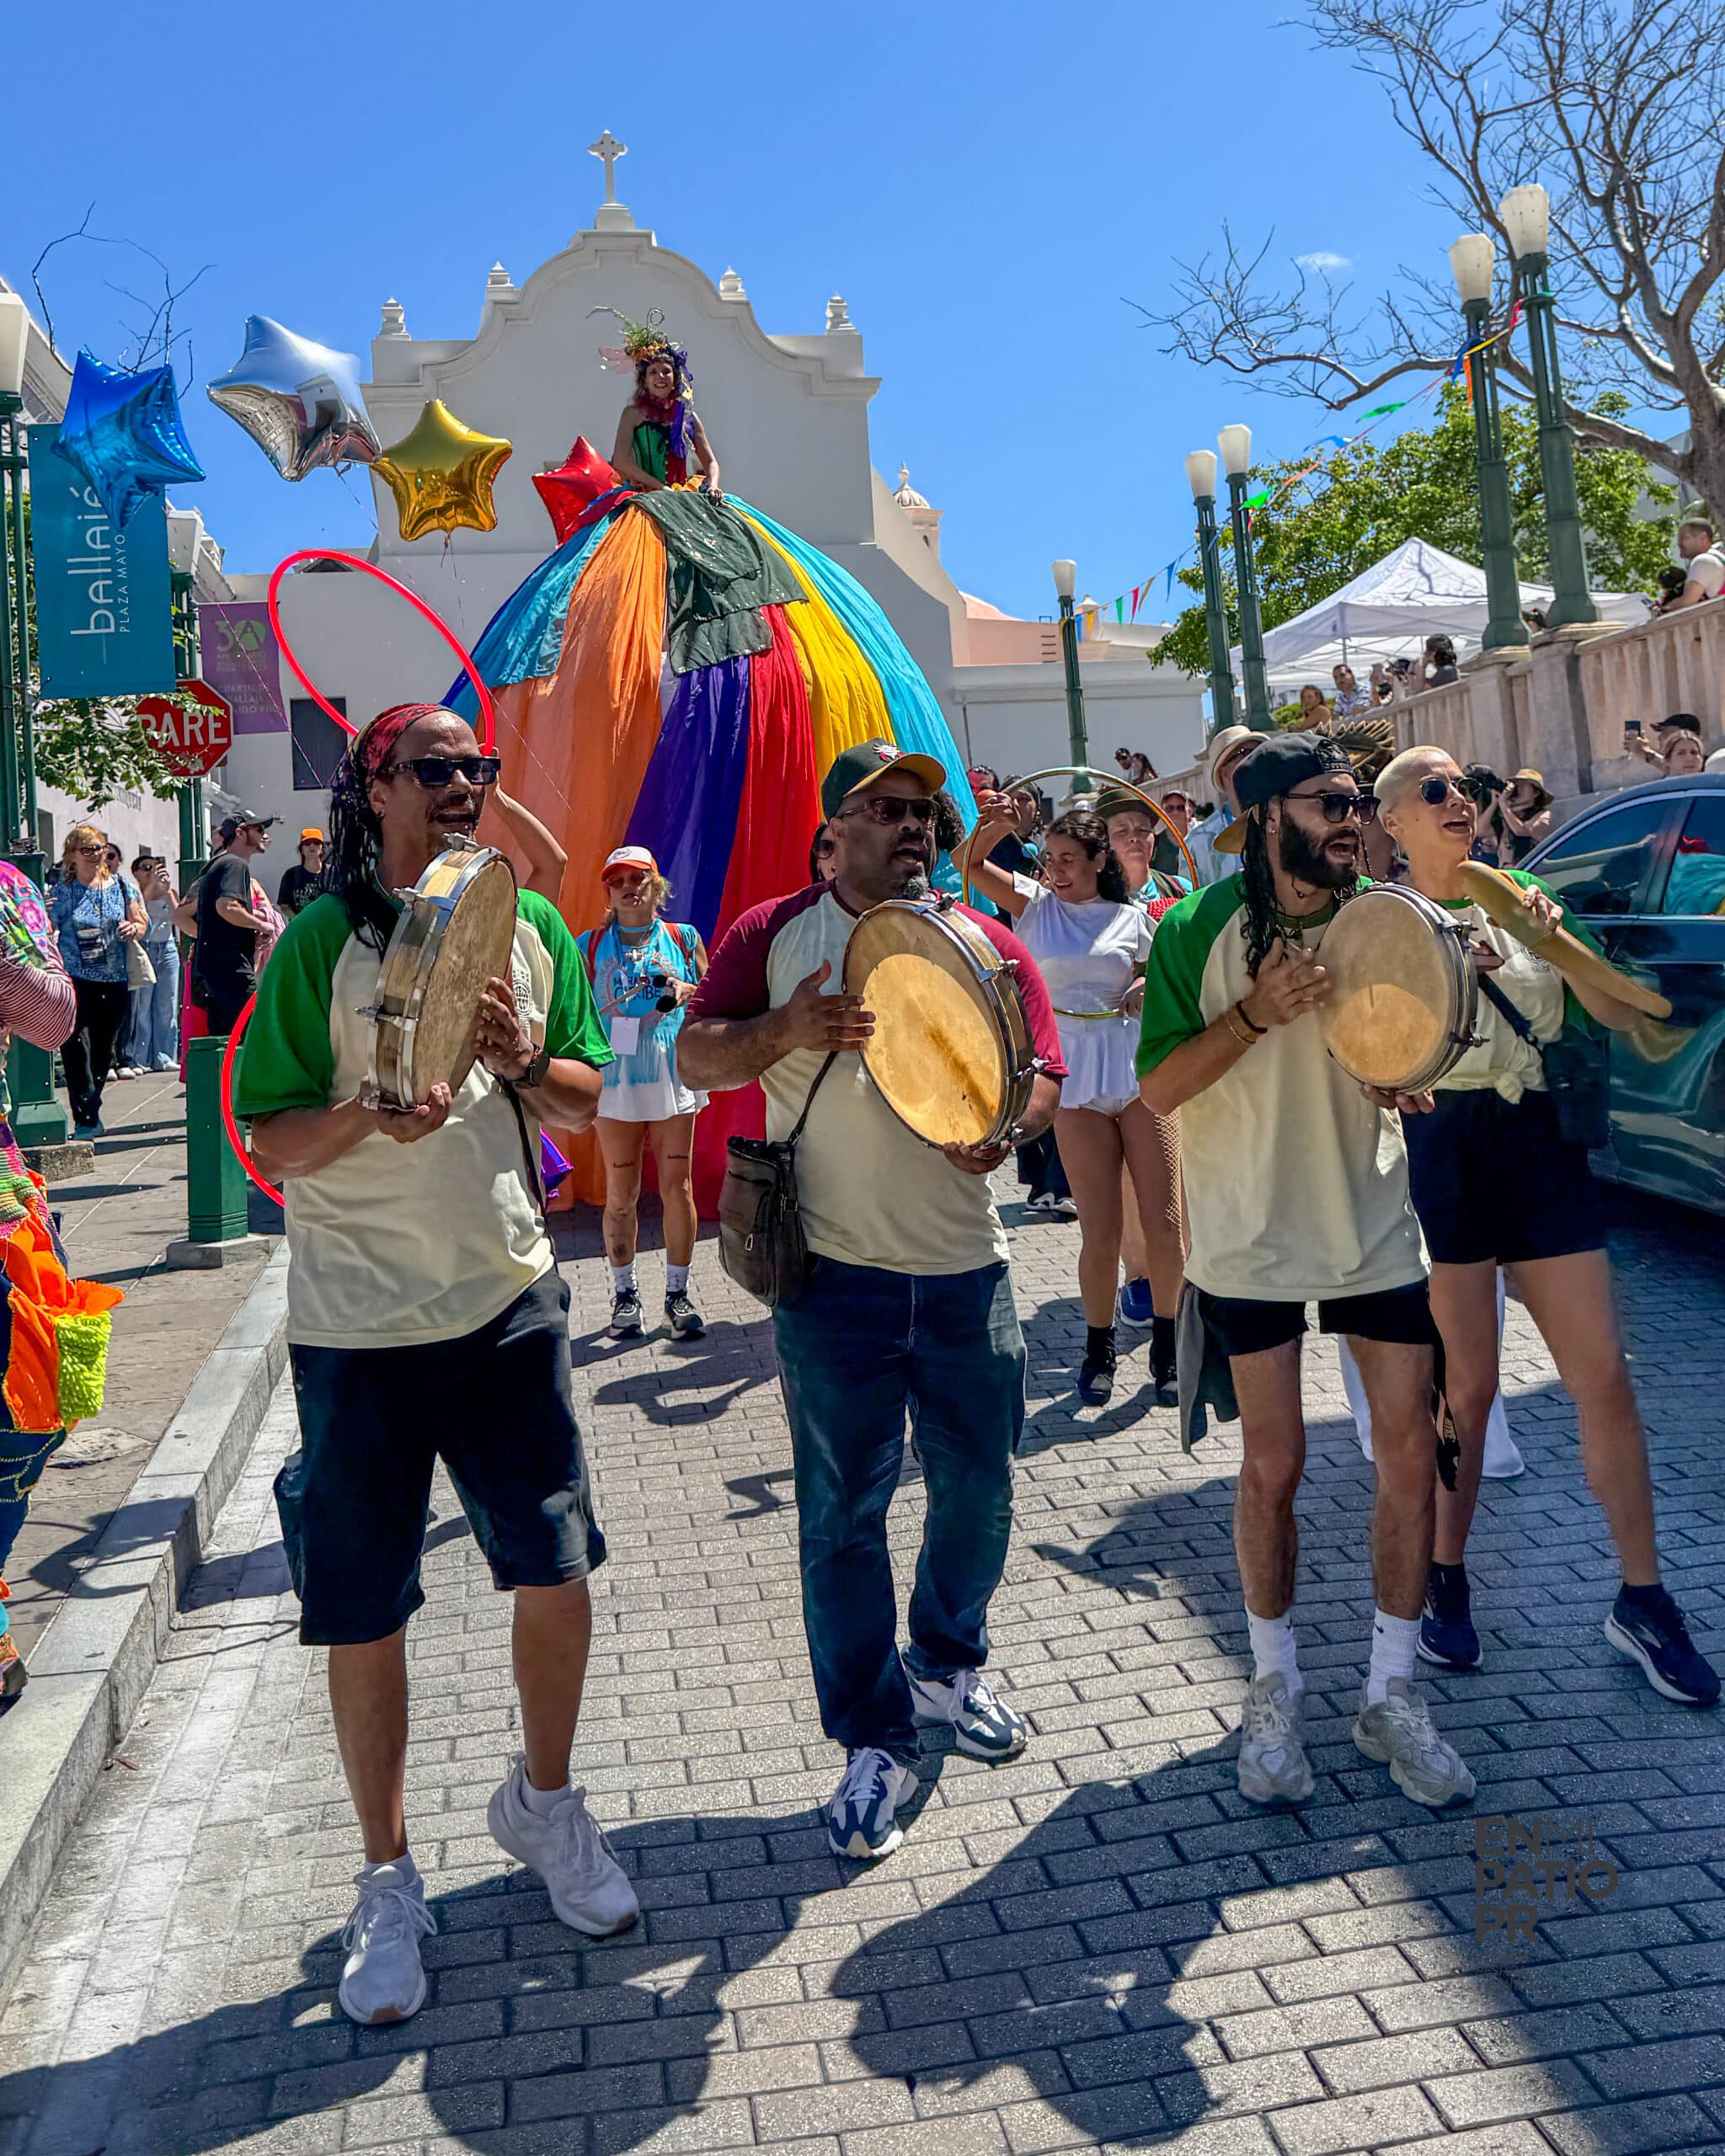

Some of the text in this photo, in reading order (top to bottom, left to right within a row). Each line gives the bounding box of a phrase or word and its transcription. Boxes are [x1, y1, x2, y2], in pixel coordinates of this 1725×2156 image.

[115, 534, 130, 632] PLAZA MAYO
[137, 712, 227, 748] PARE
